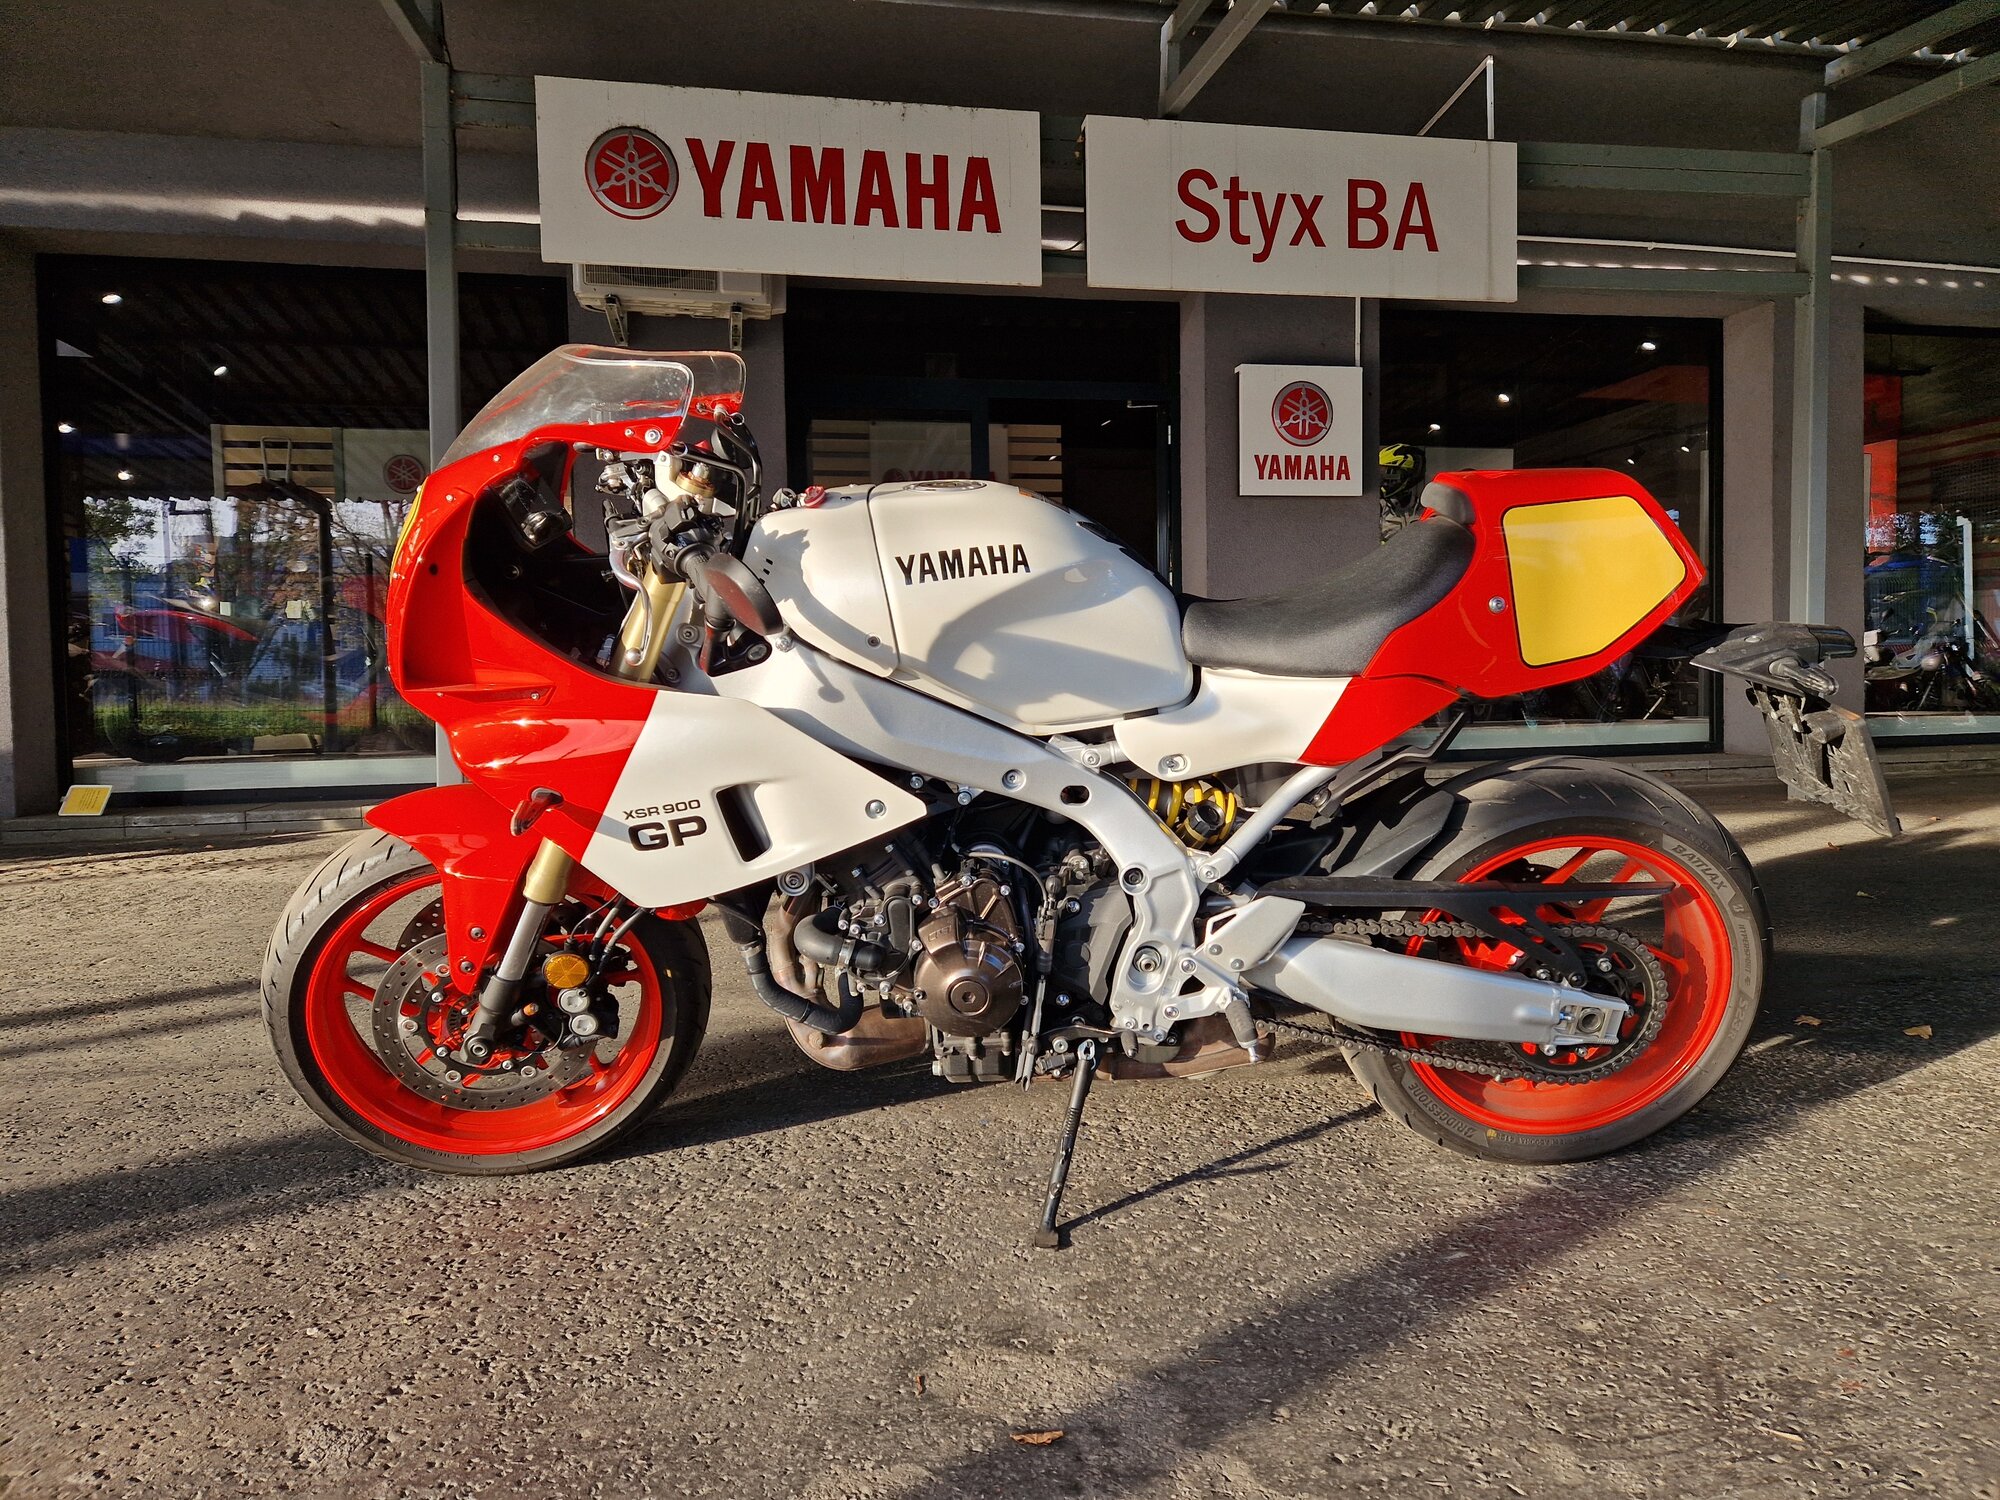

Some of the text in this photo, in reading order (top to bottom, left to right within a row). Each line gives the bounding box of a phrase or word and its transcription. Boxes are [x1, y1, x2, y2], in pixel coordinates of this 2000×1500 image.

[685, 137, 1002, 234] YAMAHA
[1175, 168, 1439, 263] Styx BA
[1254, 454, 1351, 481] YAMAHA
[895, 543, 1031, 586] YAMAHA
[623, 799, 701, 821] XSR 900
[628, 815, 708, 852] GP
[1671, 844, 1728, 890] BATTLAX
[1408, 1081, 1477, 1139] BRIDGESTONE
